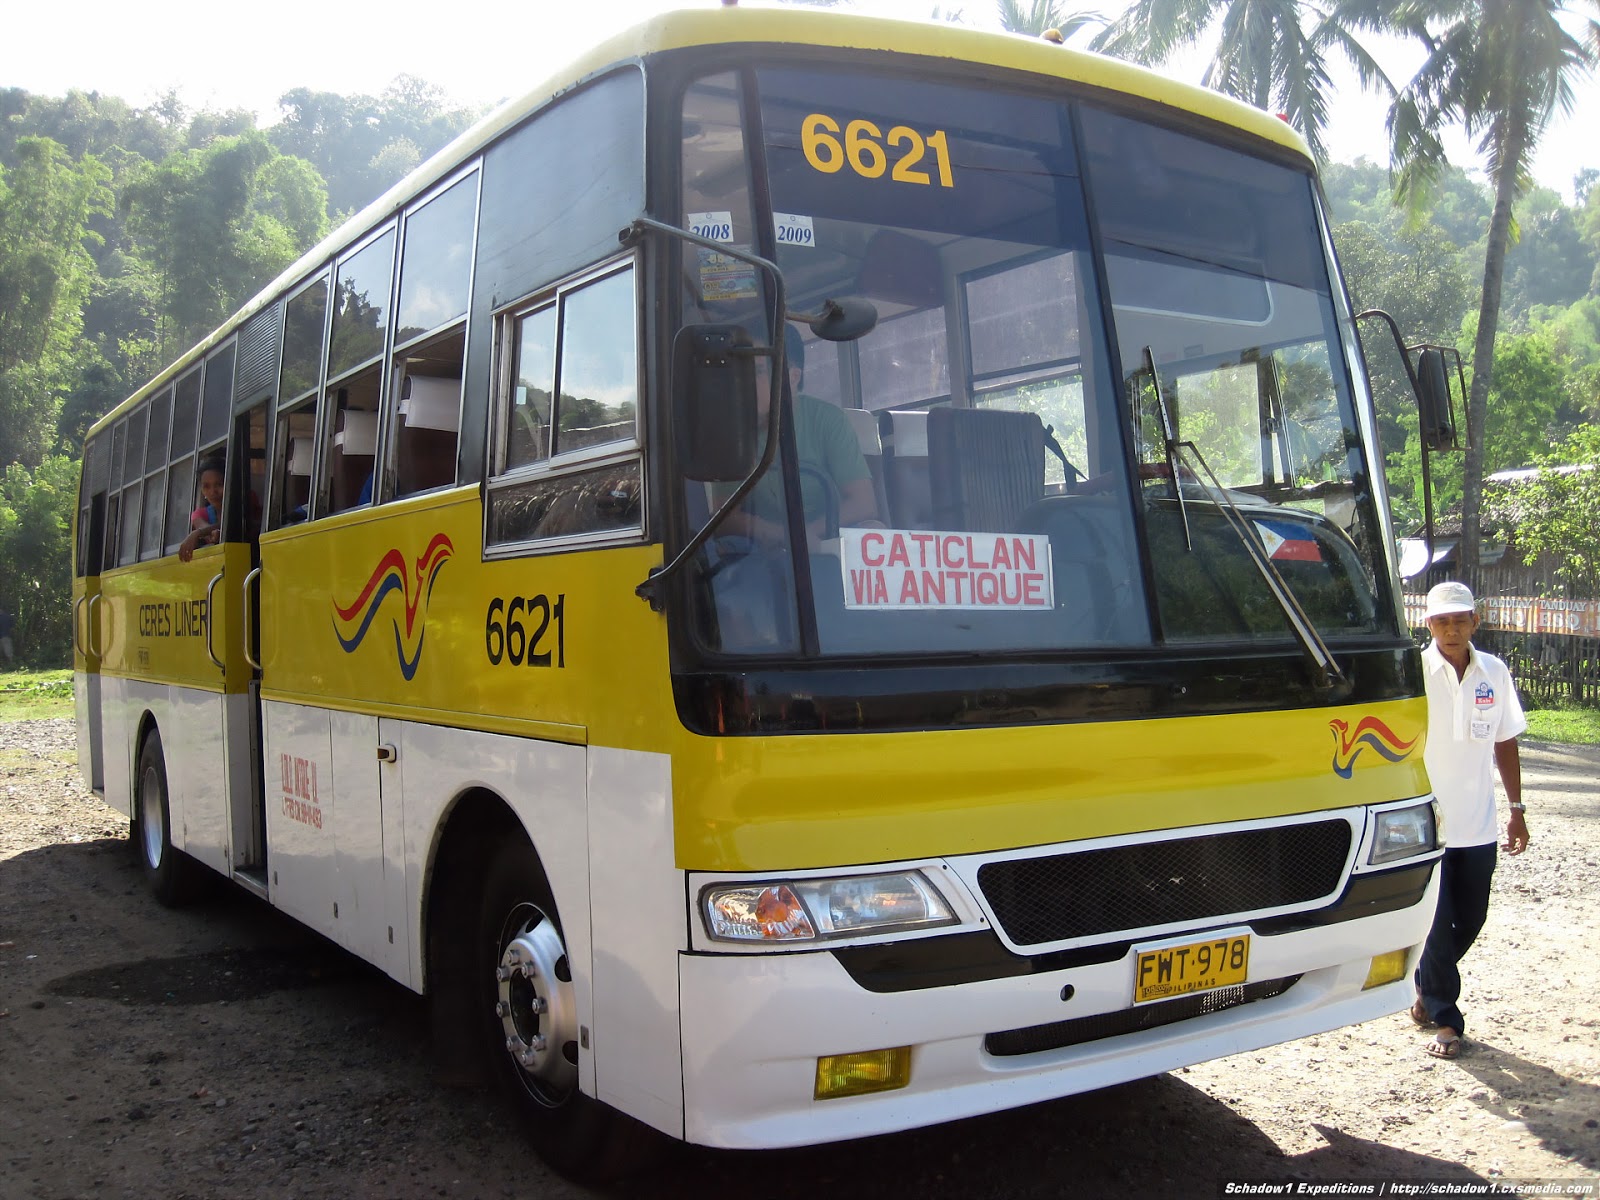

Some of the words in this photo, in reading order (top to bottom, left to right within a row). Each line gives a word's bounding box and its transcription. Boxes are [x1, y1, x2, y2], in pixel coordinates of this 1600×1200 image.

[801, 113, 954, 188] 6621
[692, 224, 730, 240] 2008
[777, 225, 812, 244] 2009
[861, 532, 1036, 570] CATICLAN
[850, 569, 888, 605] VIA
[900, 570, 1045, 605] ANTIQUE
[1489, 598, 1531, 609] TANDUAY
[1539, 600, 1587, 612] TANDUAY
[140, 603, 171, 637] CERES
[175, 600, 208, 637] LINER
[486, 593, 565, 668] 6621
[1168, 978, 1216, 994] PILIPINAS
